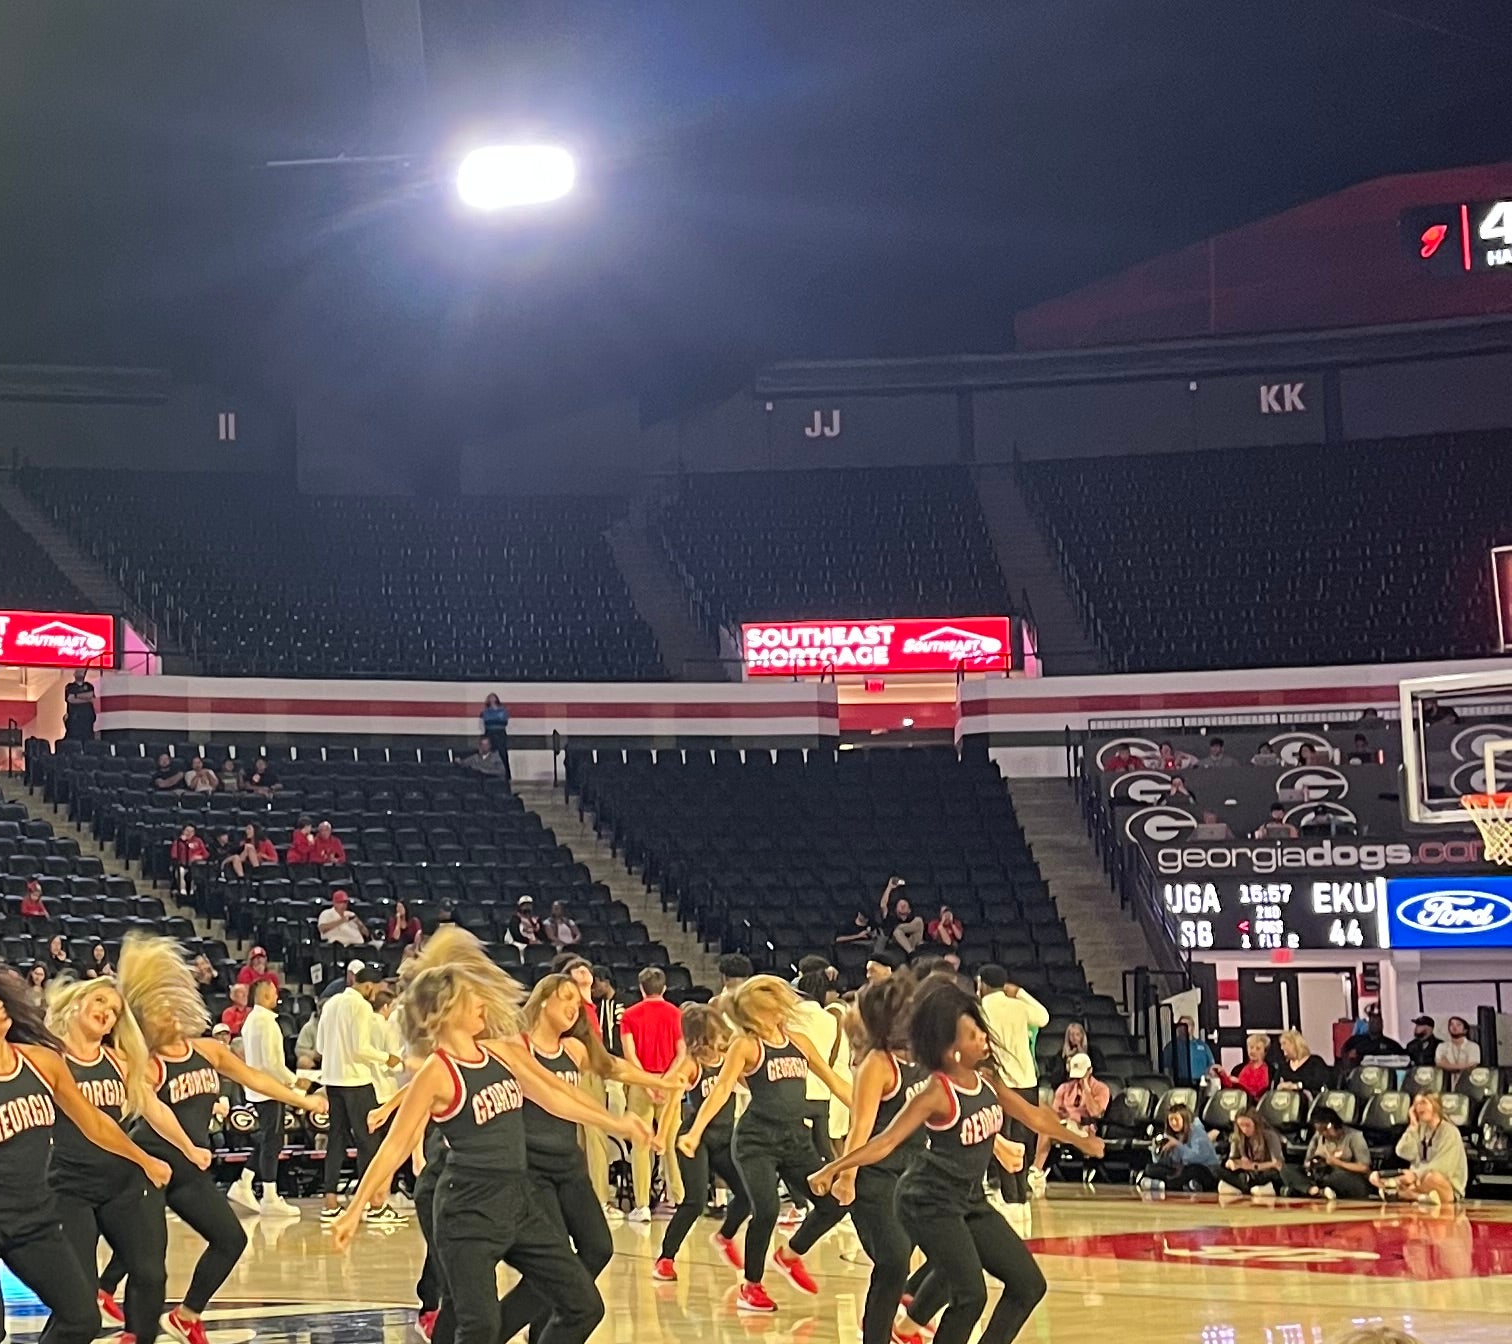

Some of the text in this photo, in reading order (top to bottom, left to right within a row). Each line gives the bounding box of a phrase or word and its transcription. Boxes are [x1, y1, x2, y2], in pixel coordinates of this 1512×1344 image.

[1259, 382, 1306, 414] KK
[804, 409, 840, 438] JJ
[746, 625, 895, 648] SOUTHEAST
[747, 646, 889, 668] MORTGAGE
[1165, 883, 1222, 913] UGA
[1313, 883, 1376, 912] EKU
[1417, 896, 1495, 926] Ford
[1329, 919, 1364, 946] 44
